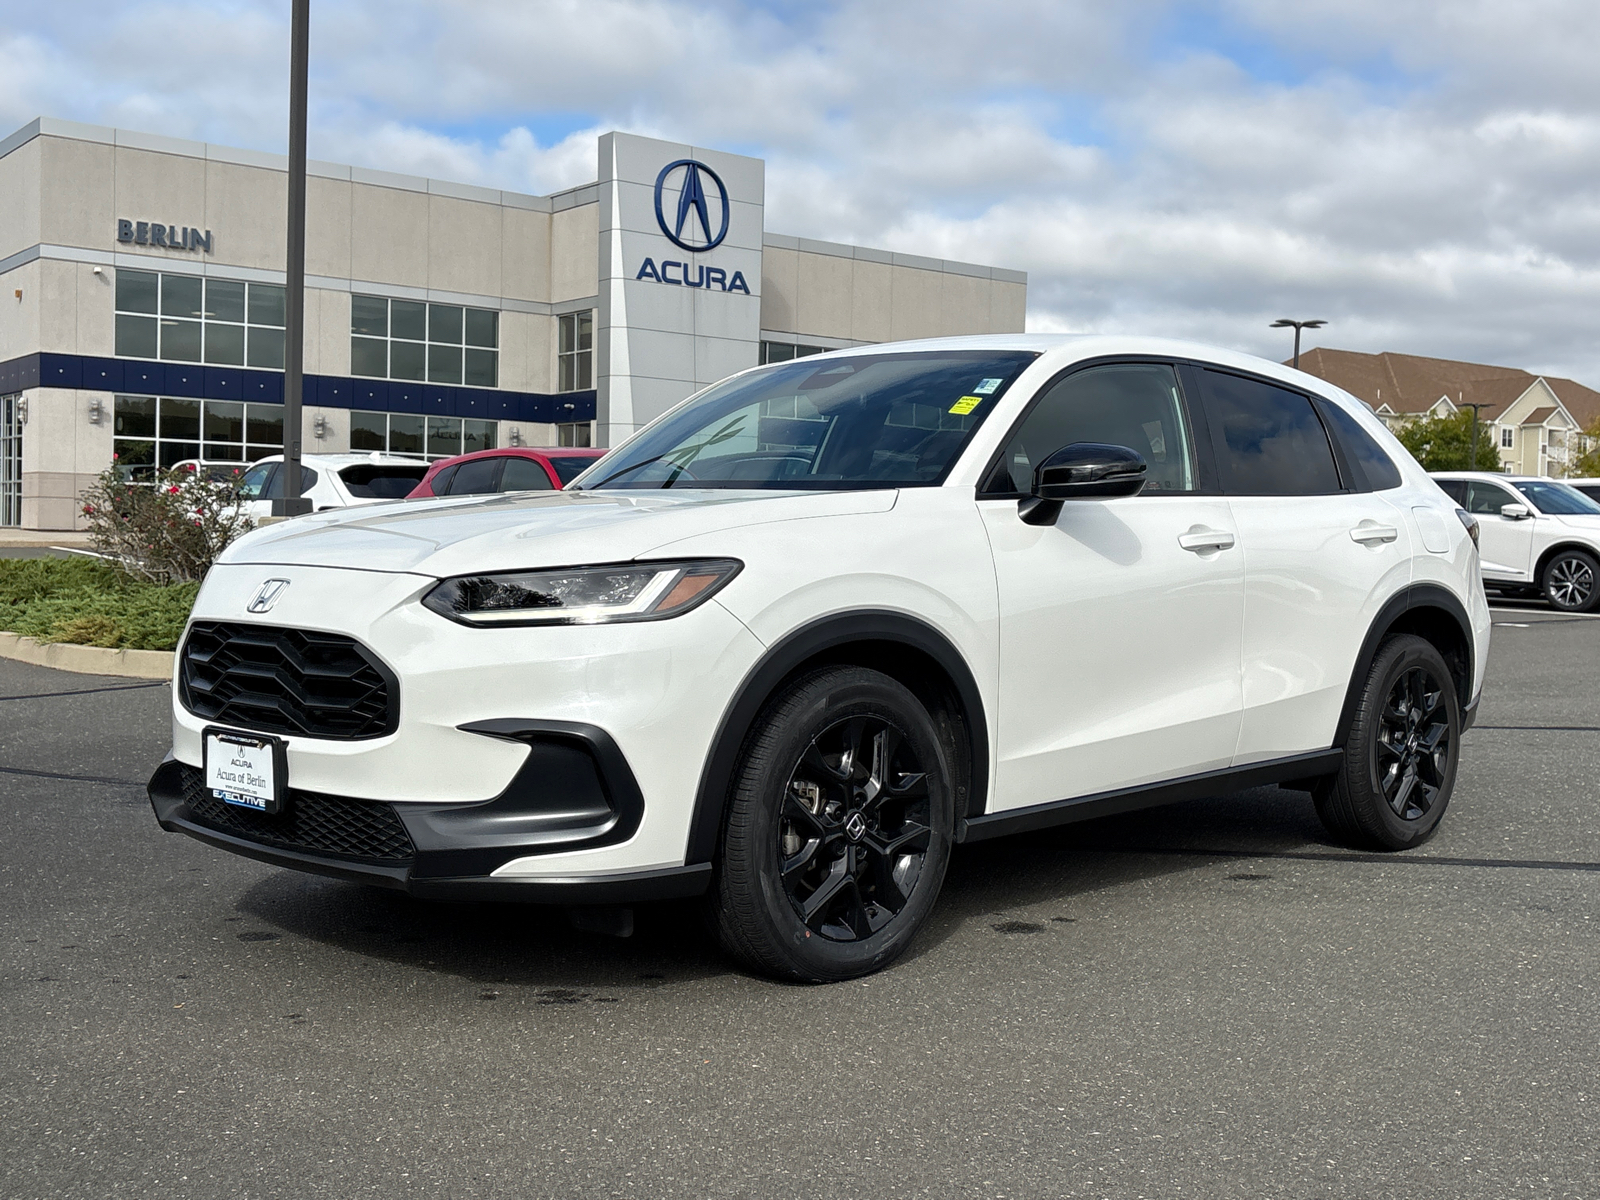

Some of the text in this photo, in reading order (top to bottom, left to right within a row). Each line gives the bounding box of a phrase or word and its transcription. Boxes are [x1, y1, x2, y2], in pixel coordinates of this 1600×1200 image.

[117, 218, 211, 253] BERLIN
[636, 257, 750, 295] ACURA
[230, 758, 253, 769] ACURA
[216, 768, 266, 788] Acura of Berlin
[212, 789, 266, 807] EXECUTIVE
